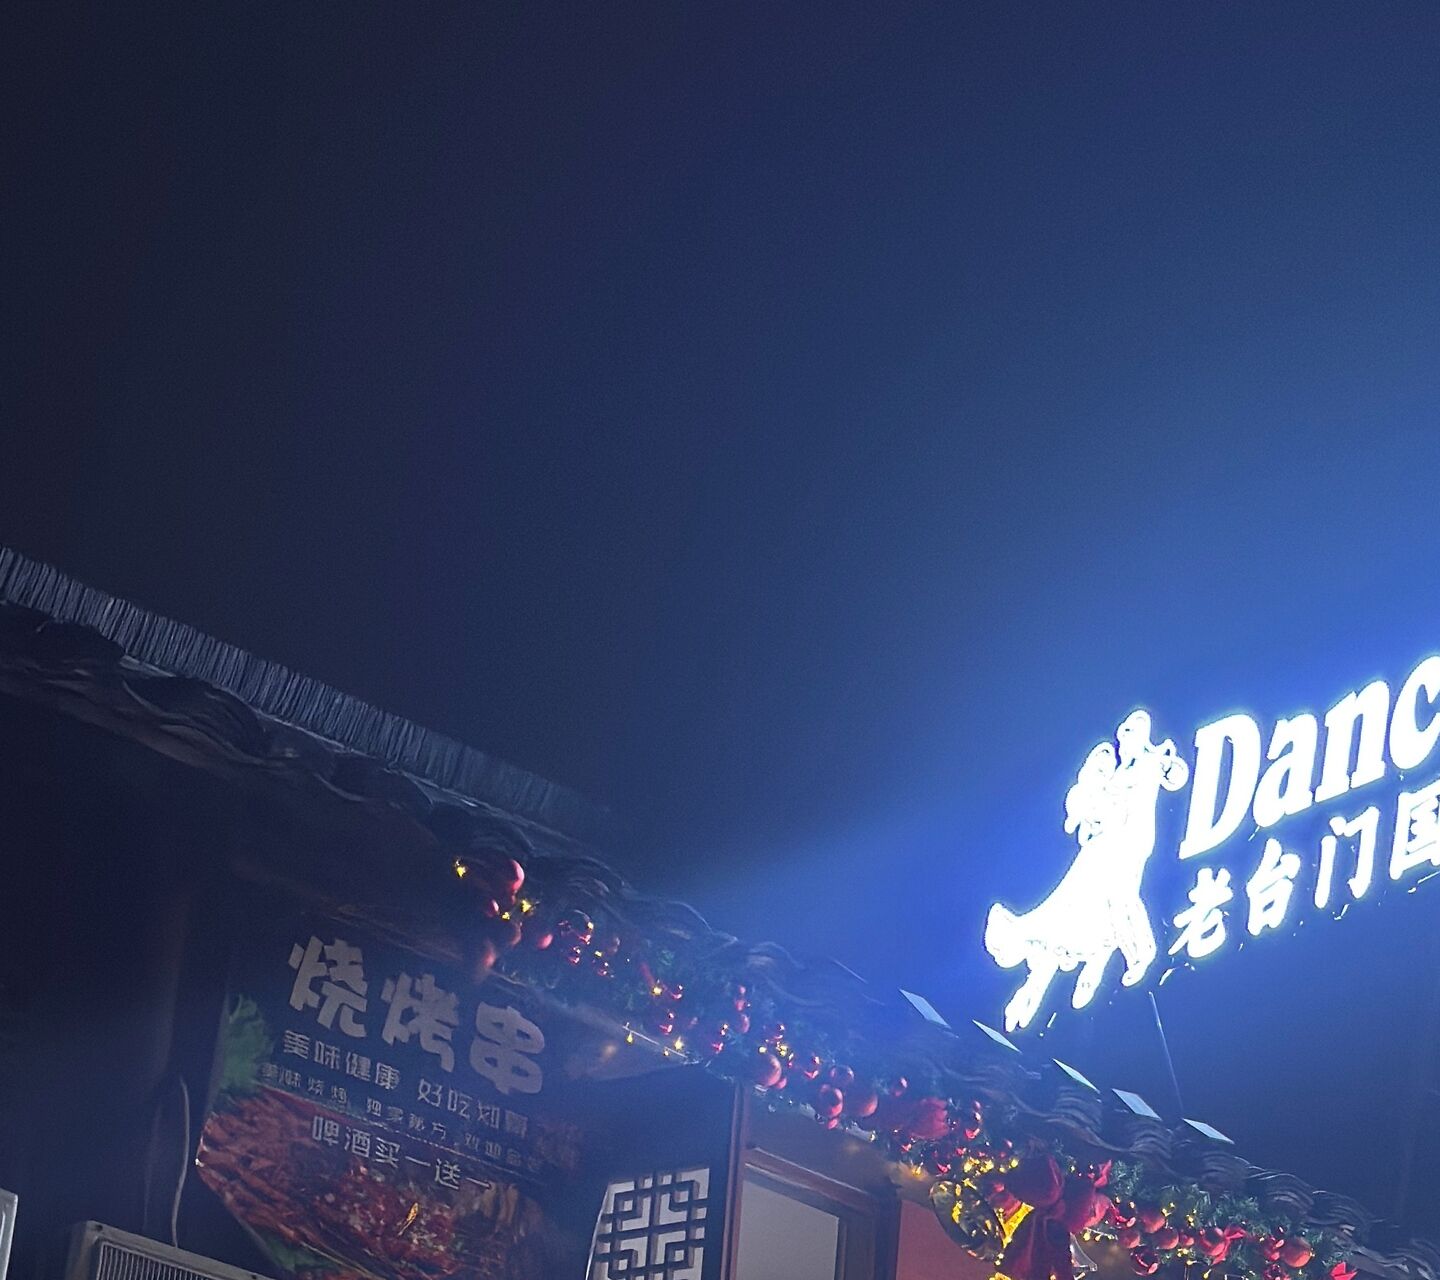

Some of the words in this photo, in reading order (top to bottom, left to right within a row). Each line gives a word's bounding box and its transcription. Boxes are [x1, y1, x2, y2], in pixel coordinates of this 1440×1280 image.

[287, 934, 547, 1096] 烧烤串
[281, 1029, 402, 1091] 美味健康
[311, 1113, 494, 1192] 啤酒买一送一
